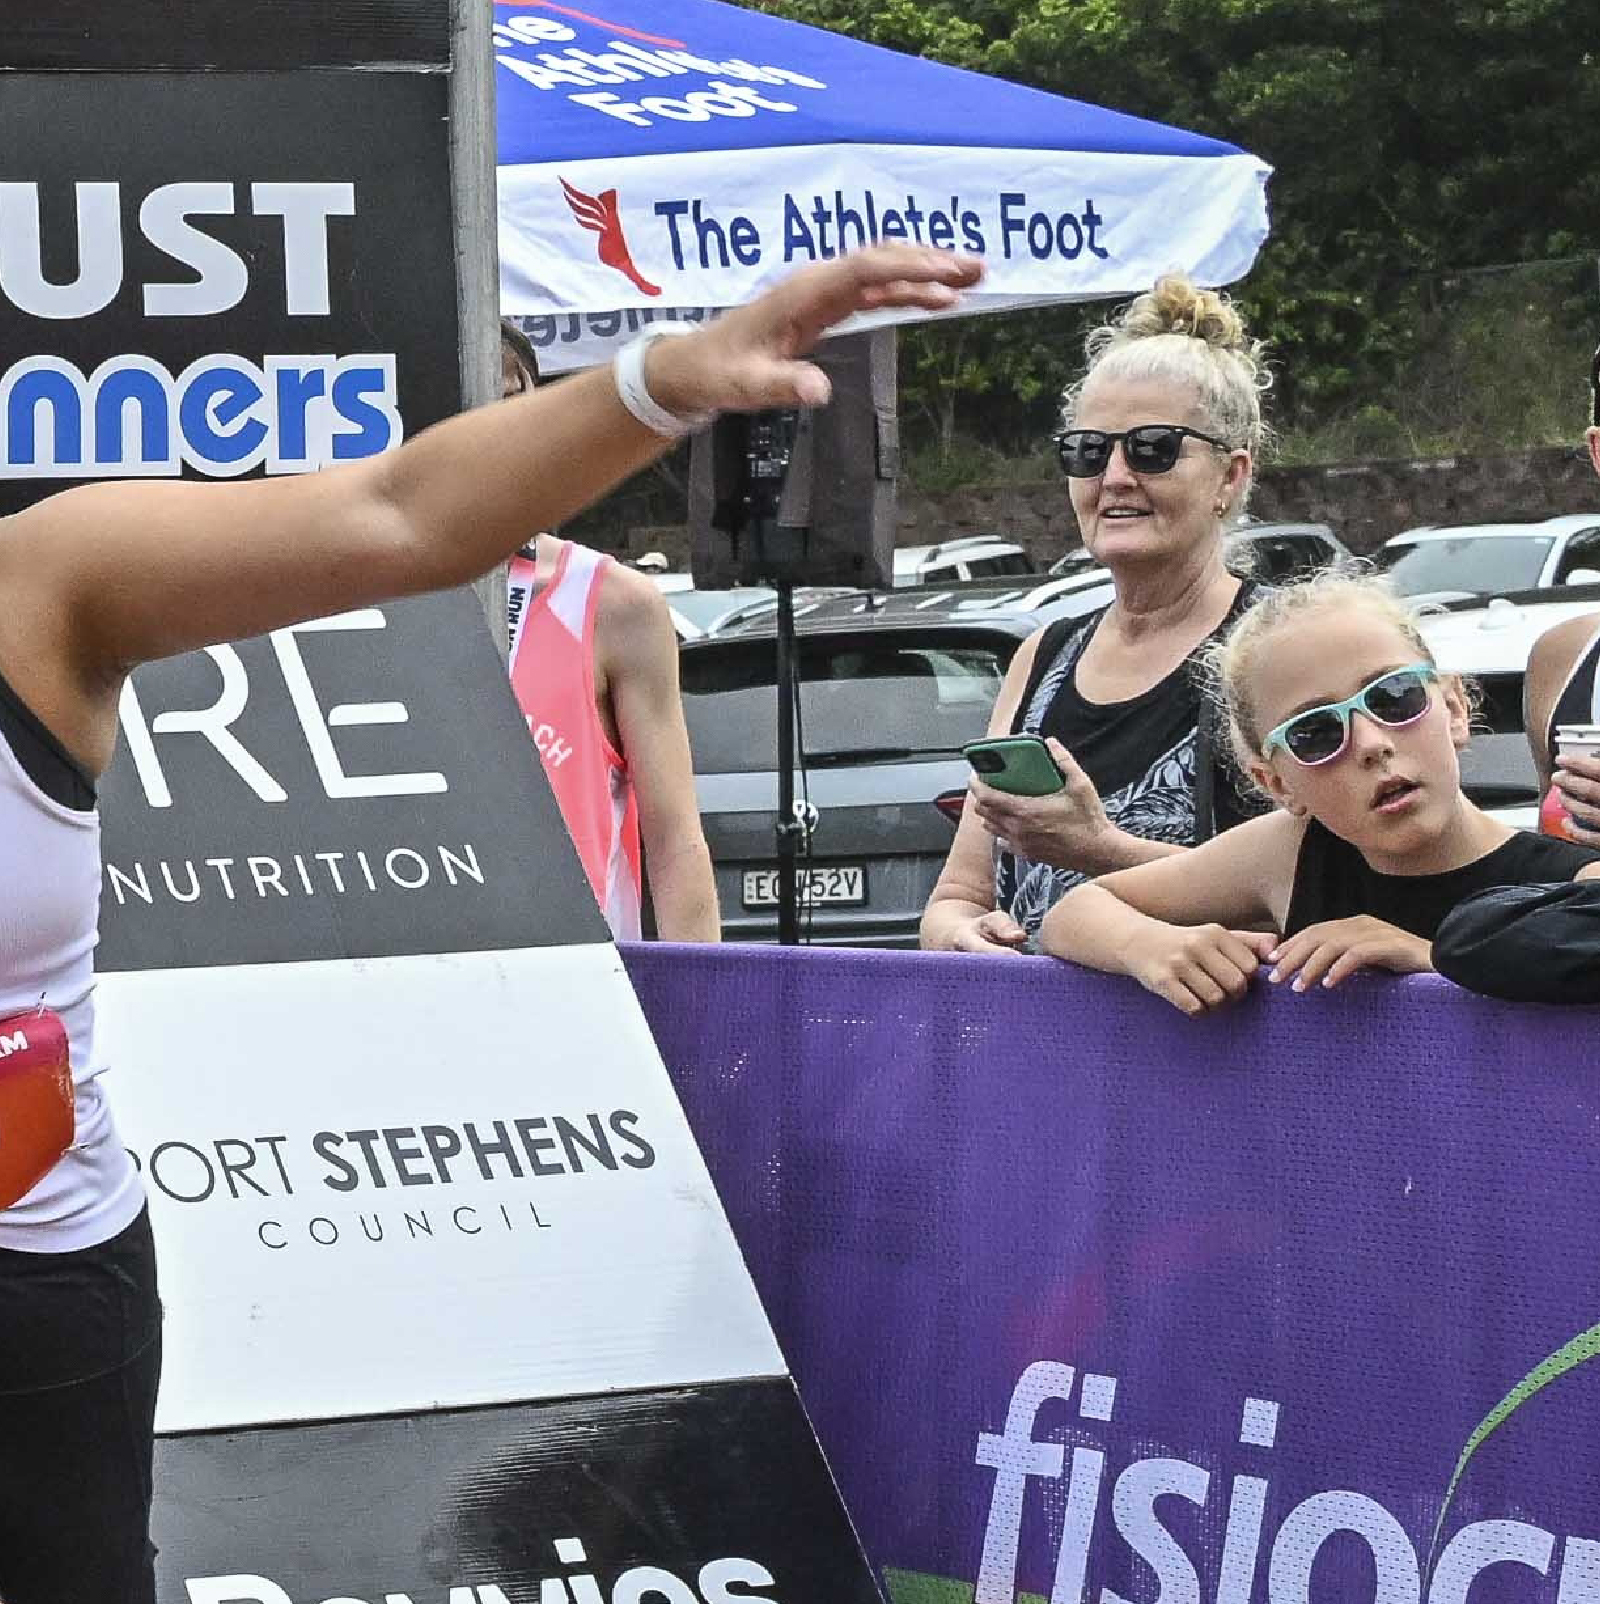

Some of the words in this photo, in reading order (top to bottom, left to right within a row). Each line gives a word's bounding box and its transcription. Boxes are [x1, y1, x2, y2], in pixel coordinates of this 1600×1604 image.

[568, 81, 798, 126] Foot
[655, 199, 761, 271] The
[1001, 192, 1111, 261] Foot
[525, 713, 573, 768] CH
[106, 844, 486, 905] NUTRITION
[126, 1135, 294, 1203] ORT
[312, 1109, 656, 1193] STEPHENS
[258, 1200, 552, 1250] COUNCIL
